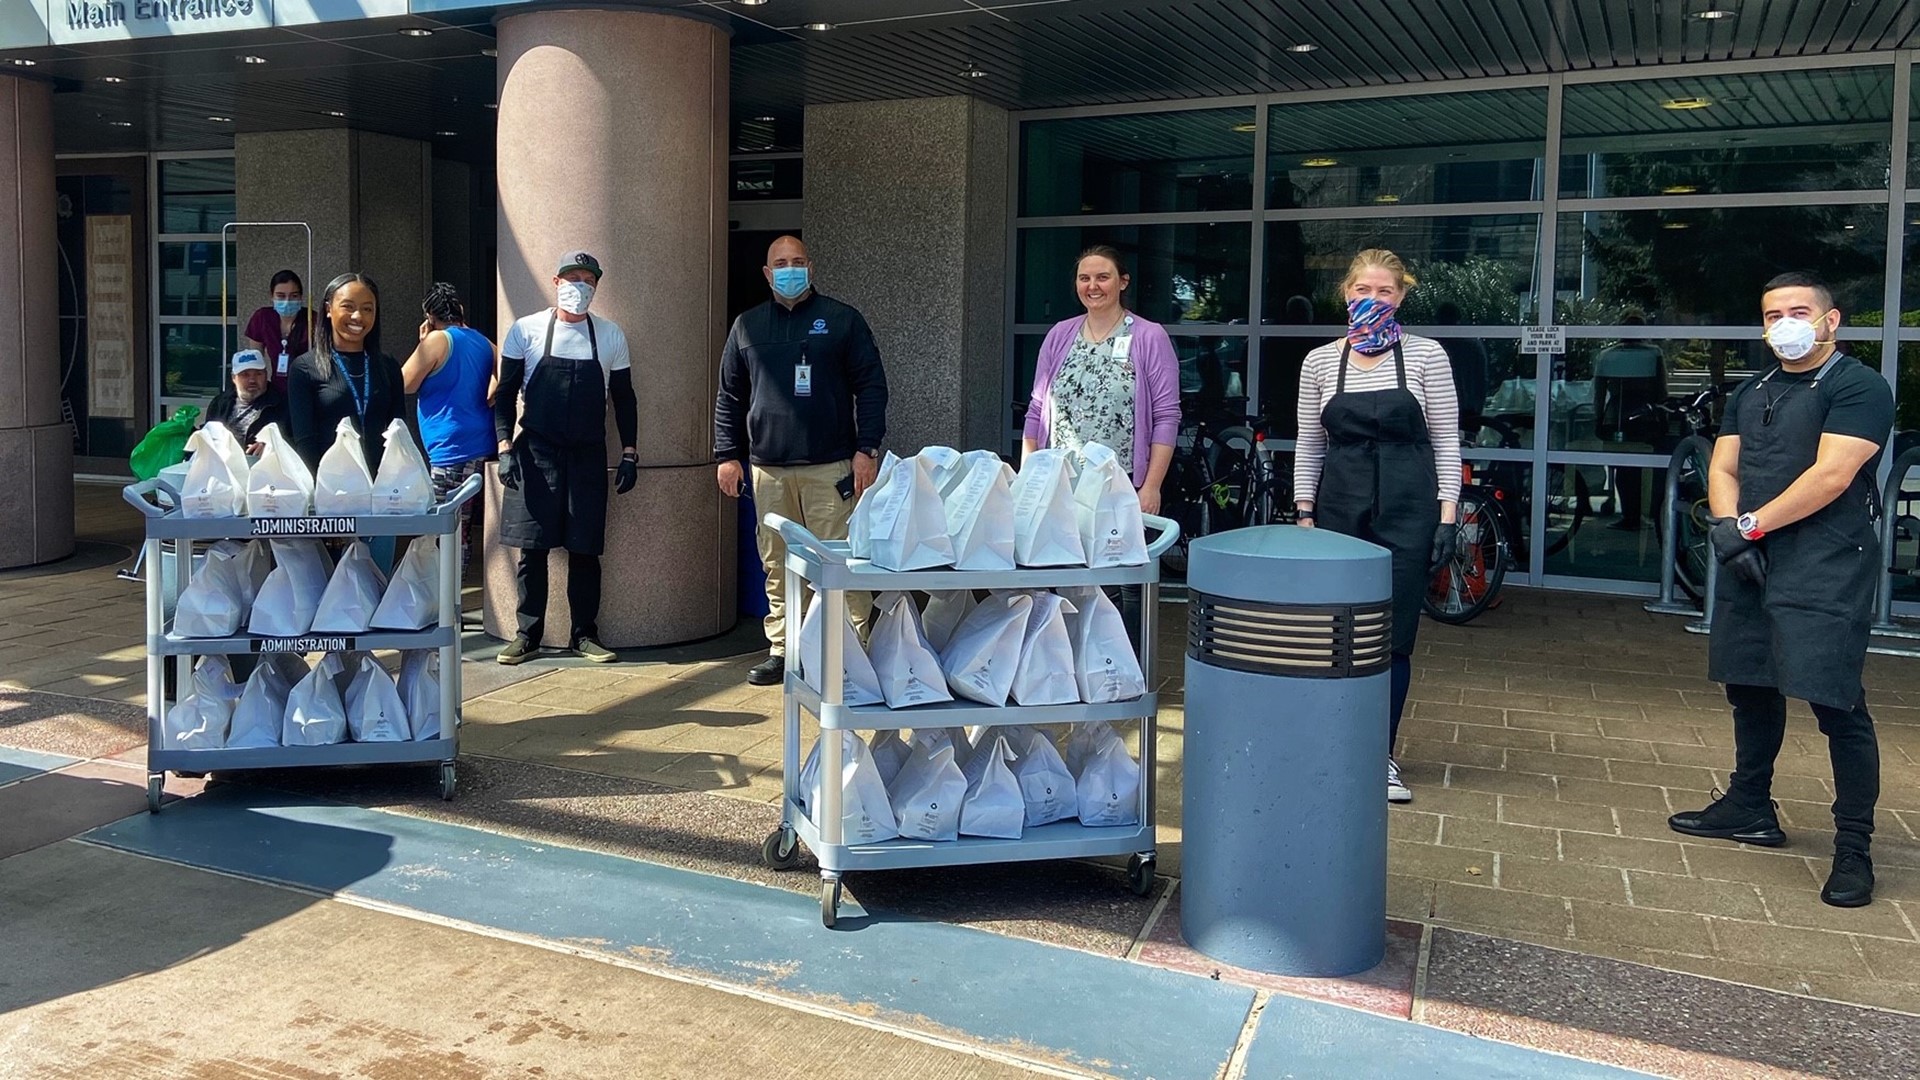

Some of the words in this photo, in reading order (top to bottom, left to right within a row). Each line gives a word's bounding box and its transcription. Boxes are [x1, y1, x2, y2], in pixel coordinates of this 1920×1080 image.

[66, 0, 124, 29] Main
[134, 0, 254, 21] Entrance
[252, 518, 355, 534] ADMINISTRATION
[260, 638, 346, 651] ADMINISTRATION
